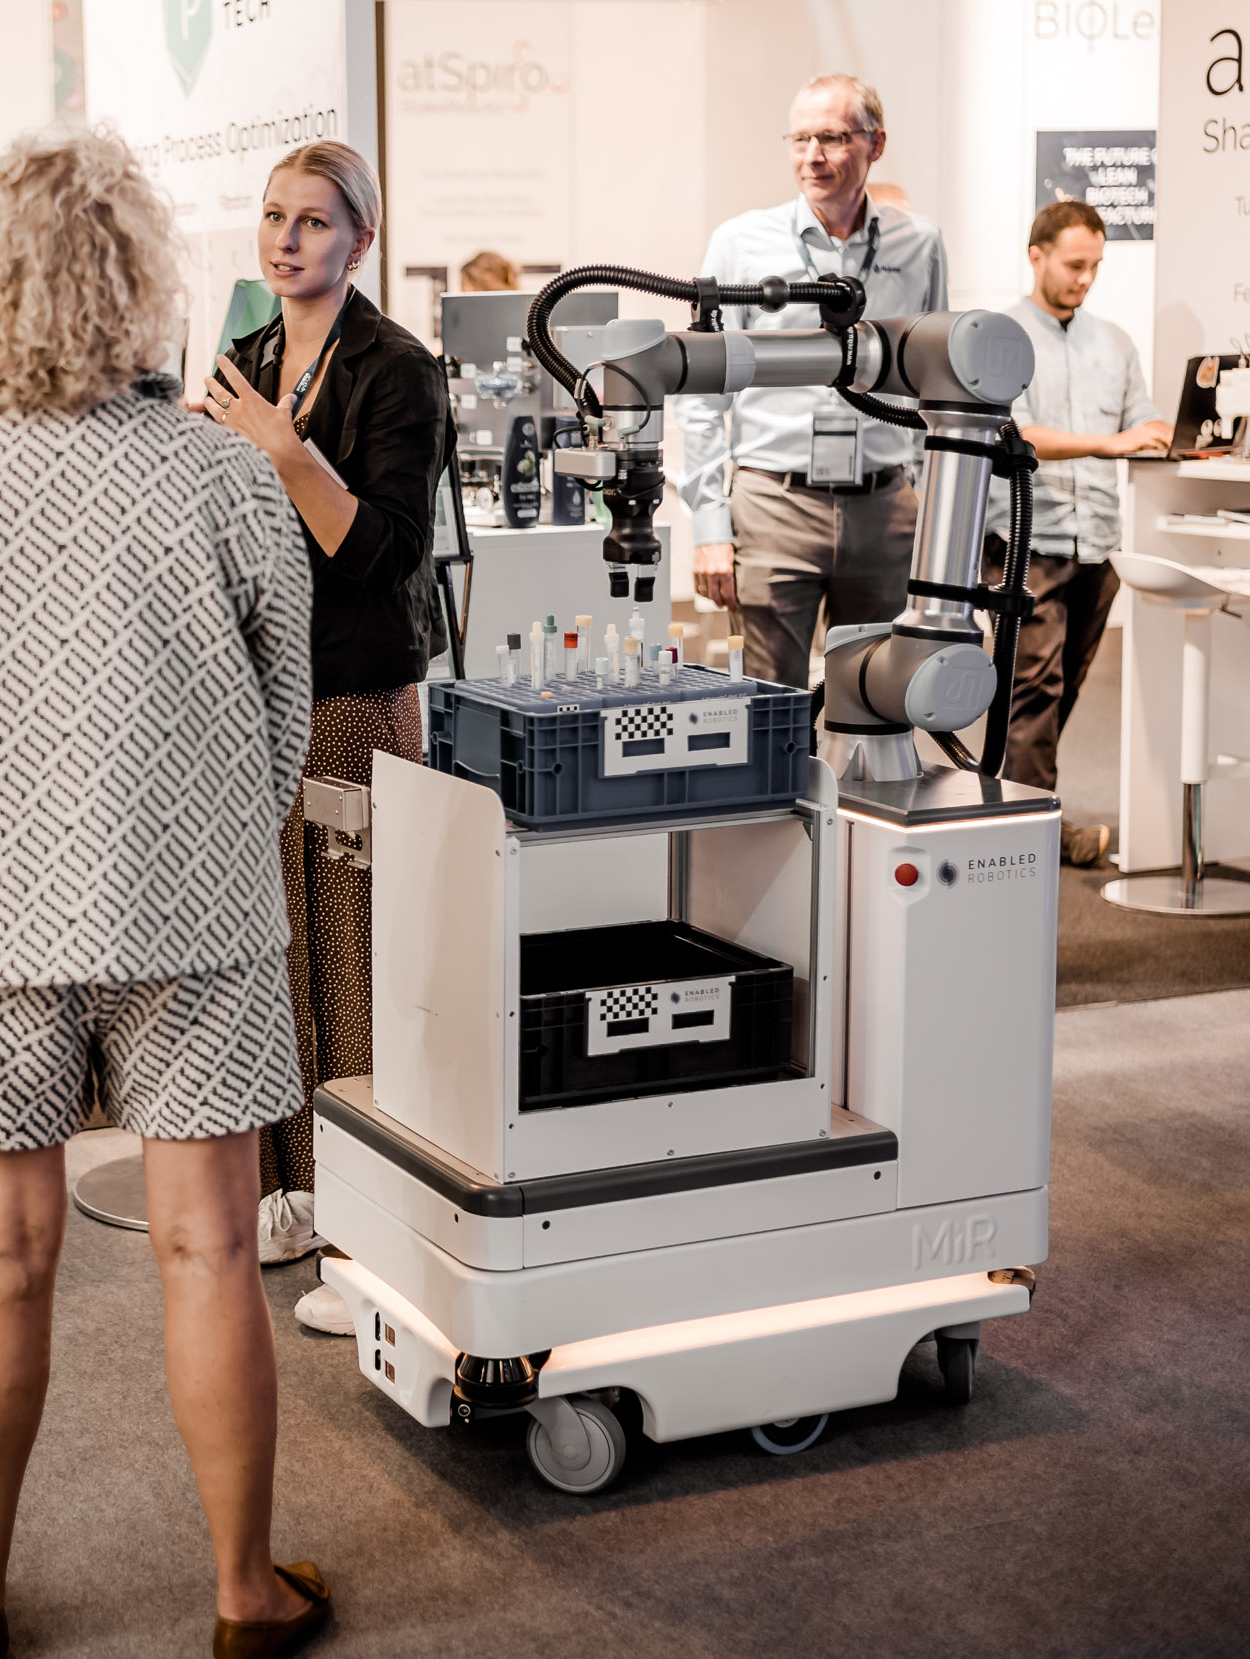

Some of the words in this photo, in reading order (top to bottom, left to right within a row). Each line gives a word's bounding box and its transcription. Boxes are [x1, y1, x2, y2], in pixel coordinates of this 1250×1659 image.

[224, 0, 271, 29] TECH
[163, 131, 222, 164] Process
[226, 102, 338, 165] Optimization
[845, 326, 854, 366] www.reiku.de
[703, 708, 738, 718] ENABLED
[968, 853, 1036, 870] ENABLED
[967, 867, 1036, 884] ROBOTICS
[684, 987, 720, 997] ENABLED
[911, 1214, 998, 1271] MiR
